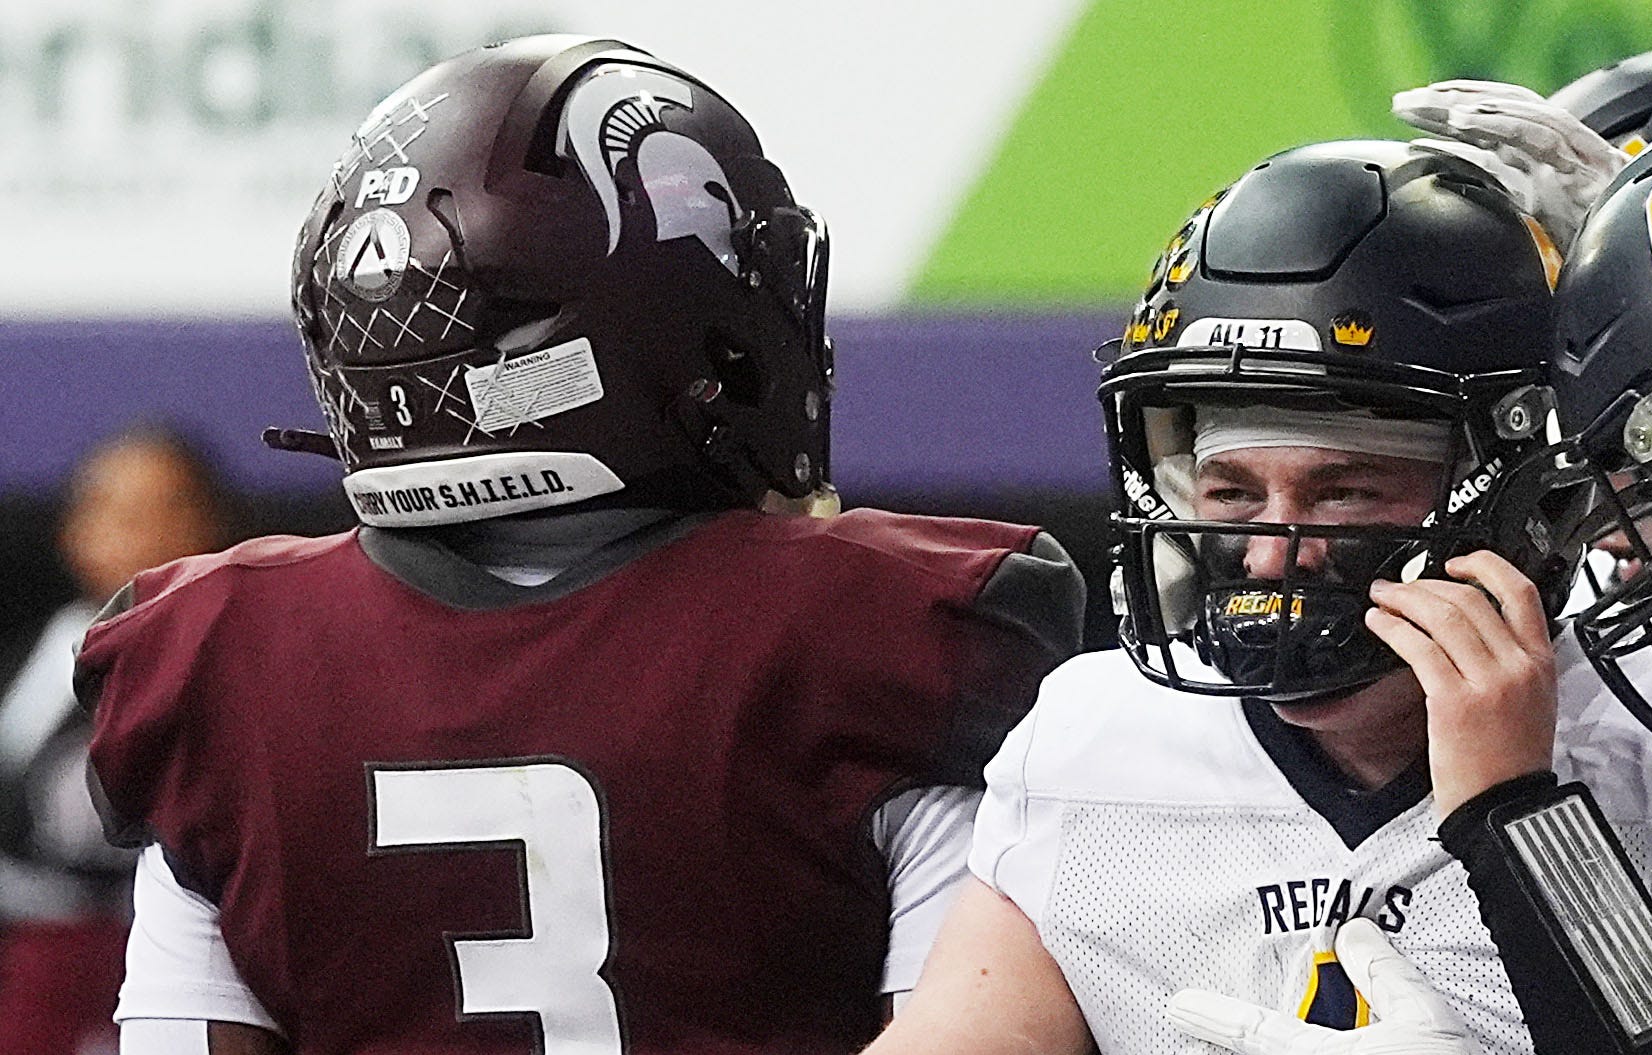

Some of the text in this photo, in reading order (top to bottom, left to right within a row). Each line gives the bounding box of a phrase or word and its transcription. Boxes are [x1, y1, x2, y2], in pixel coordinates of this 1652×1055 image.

[504, 351, 551, 371] WARNING
[390, 385, 413, 427] 3
[384, 486, 440, 514] YOUR
[438, 469, 575, 508] S.H.I.E.L.D.
[1256, 878, 1413, 934] REGALS
